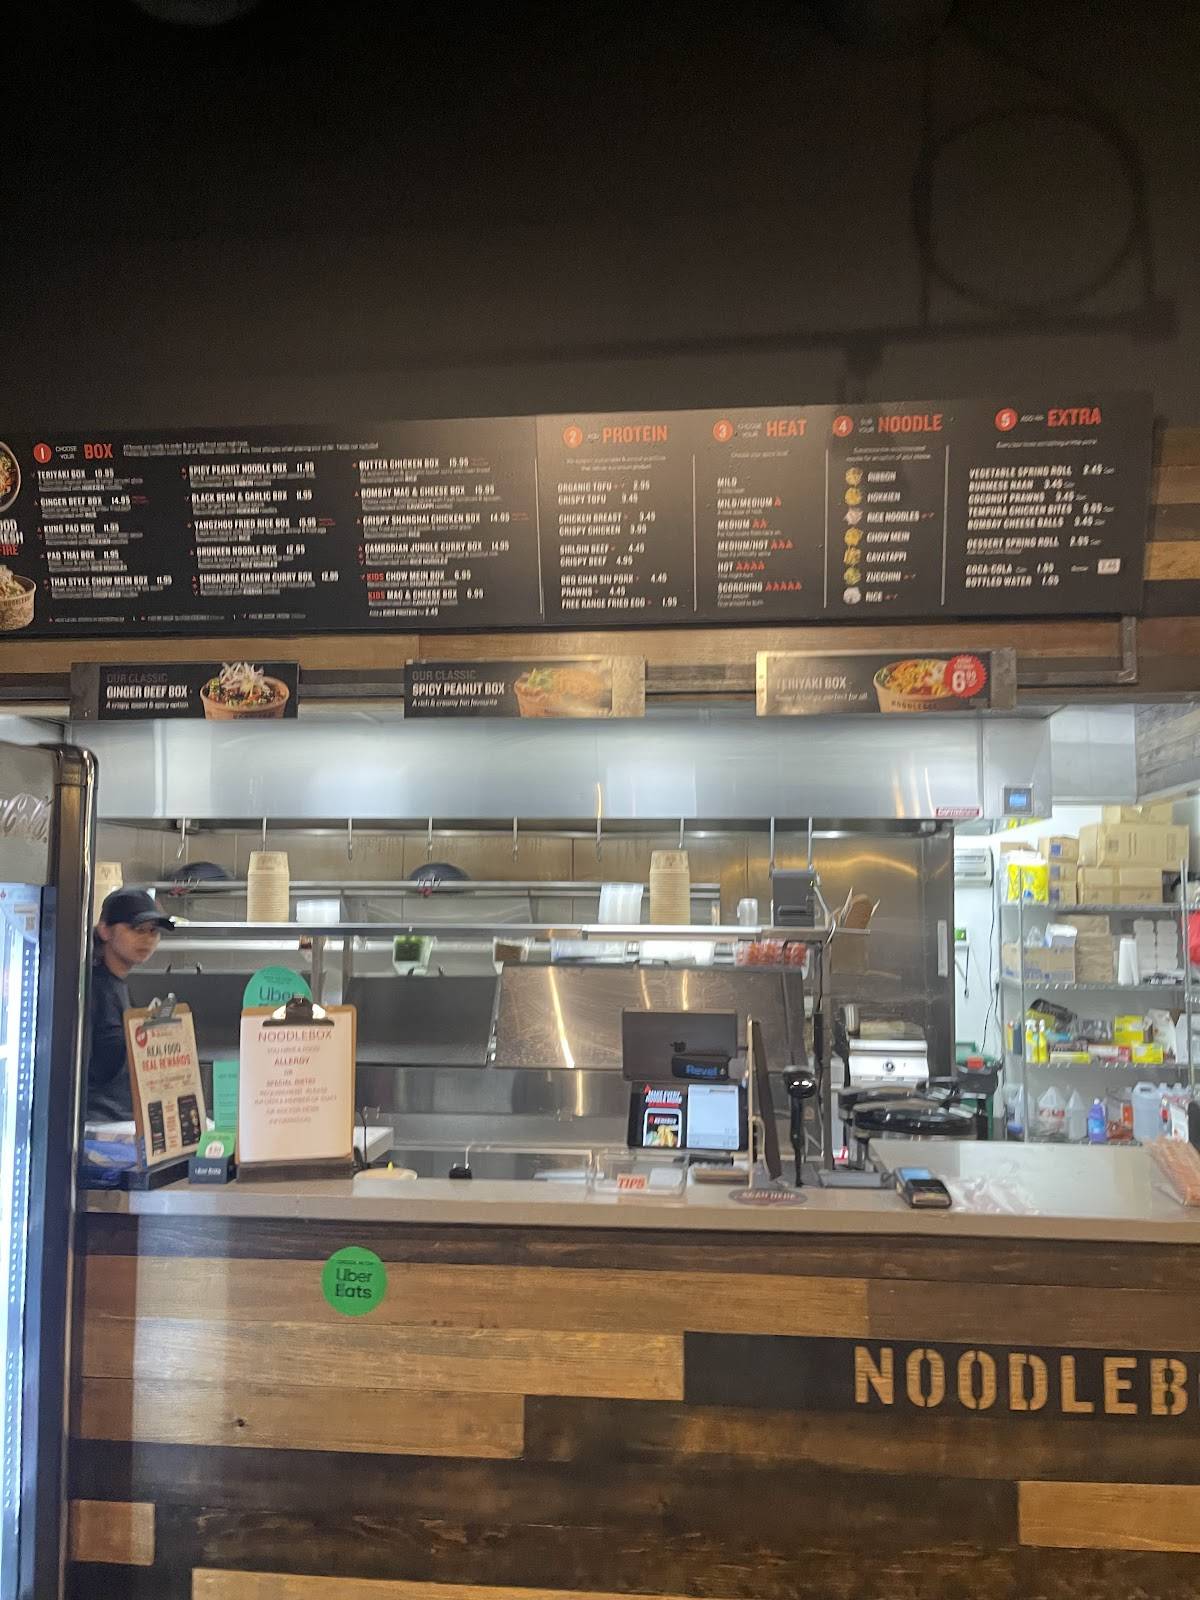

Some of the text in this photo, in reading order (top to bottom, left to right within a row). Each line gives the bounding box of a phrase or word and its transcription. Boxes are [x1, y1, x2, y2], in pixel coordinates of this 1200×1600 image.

[1001, 408, 1102, 427] 5 EXTRA
[766, 420, 807, 437] HEAT
[838, 414, 943, 433] 4 NOODLE
[602, 425, 668, 443] PROTEIN
[84, 444, 114, 460] BOX
[189, 463, 287, 475] SPICY PEANUT NOODLE BOX
[359, 458, 439, 469] BUTTER CHICKEN BOX
[38, 470, 86, 479] TERIYAKI BOX
[867, 471, 896, 482] RIBBON
[969, 466, 1072, 479] VEGETABLE SPRING ROLL
[558, 482, 612, 493] ORGANIC TOFU
[717, 477, 737, 488] MILD
[969, 480, 1034, 492] BURMESE NAAN
[192, 491, 287, 501] BLACK BEAN GARLIC BOX
[361, 486, 465, 498] BOMBAY MAC CHEESE BOX
[867, 492, 900, 502] HOKKIEN
[40, 496, 102, 506] GINGER BEEF BOX
[558, 494, 606, 505] CRISPY TOFU
[717, 498, 773, 509] MILD/MEDIUM
[968, 492, 1045, 505] COCONUT PRAWNS
[969, 504, 1072, 517] TEMPURA CHICKEN BITES
[363, 514, 480, 526] CRISPY SHANGHAI CHICKEN BOX
[558, 513, 622, 524] CHICKEN BREAST
[866, 511, 920, 523] RICE NOODLES
[44, 524, 95, 534] KUNG PAO BOX
[194, 518, 290, 530] YANGZHOU FRIED RICE BOX
[717, 519, 750, 530] MEDIUM
[968, 517, 1064, 531] BOMBAY CHEESE BALLS
[559, 525, 621, 536] CRISPY CHICKEN
[866, 532, 910, 543] CHOW MEIN
[967, 536, 1059, 550] DESSERT SPRING ROLL
[197, 545, 277, 556] DRUNKEN NOODLE BOX
[365, 542, 482, 553] CAMBODIAN JUNGLE CURRY BOX
[560, 544, 609, 555] SIRLOIN BEEF
[717, 540, 768, 551] MEDIUM/HOT
[47, 551, 95, 560] PAD THAI BOX
[866, 552, 907, 563] CAVATAPPI
[560, 556, 606, 567] CRISPY BEEF
[717, 562, 734, 572] HOT
[50, 576, 148, 586] THAI STYLE CHOW MEIN BOX
[200, 572, 312, 583] SINGAPORE CASHEW CURRY BOX
[367, 570, 444, 581] KIDS CHOW MEIN BOX
[578, 575, 598, 585] CHAR
[599, 575, 612, 584] SIU
[613, 574, 634, 584] PORK
[866, 572, 901, 583] ZUCCHINI
[717, 582, 763, 593] SCORCHING
[966, 576, 1032, 588] BOTTLED WATER
[368, 589, 457, 600] KIDS MAC CHEESE BOX
[561, 588, 592, 597] PRAWNS
[866, 592, 883, 602] RICE
[562, 599, 580, 609] FREE
[581, 599, 606, 609] RANGE
[608, 598, 629, 608] FRIED
[106, 673, 168, 684] OUR CLASSIC
[412, 670, 477, 681] OUR CLASSIC
[825, 675, 847, 689] BOX
[106, 685, 188, 698] GINGER BEEF BOX
[412, 682, 504, 696] SPICY PEANUT BOX
[258, 1029, 332, 1042] NOODLEBOX
[686, 1064, 718, 1076] Revel
[619, 1177, 644, 1189] TIPS
[336, 1268, 373, 1282] Uber
[336, 1284, 372, 1298] Eats
[854, 1346, 1200, 1416] NOODLEB
